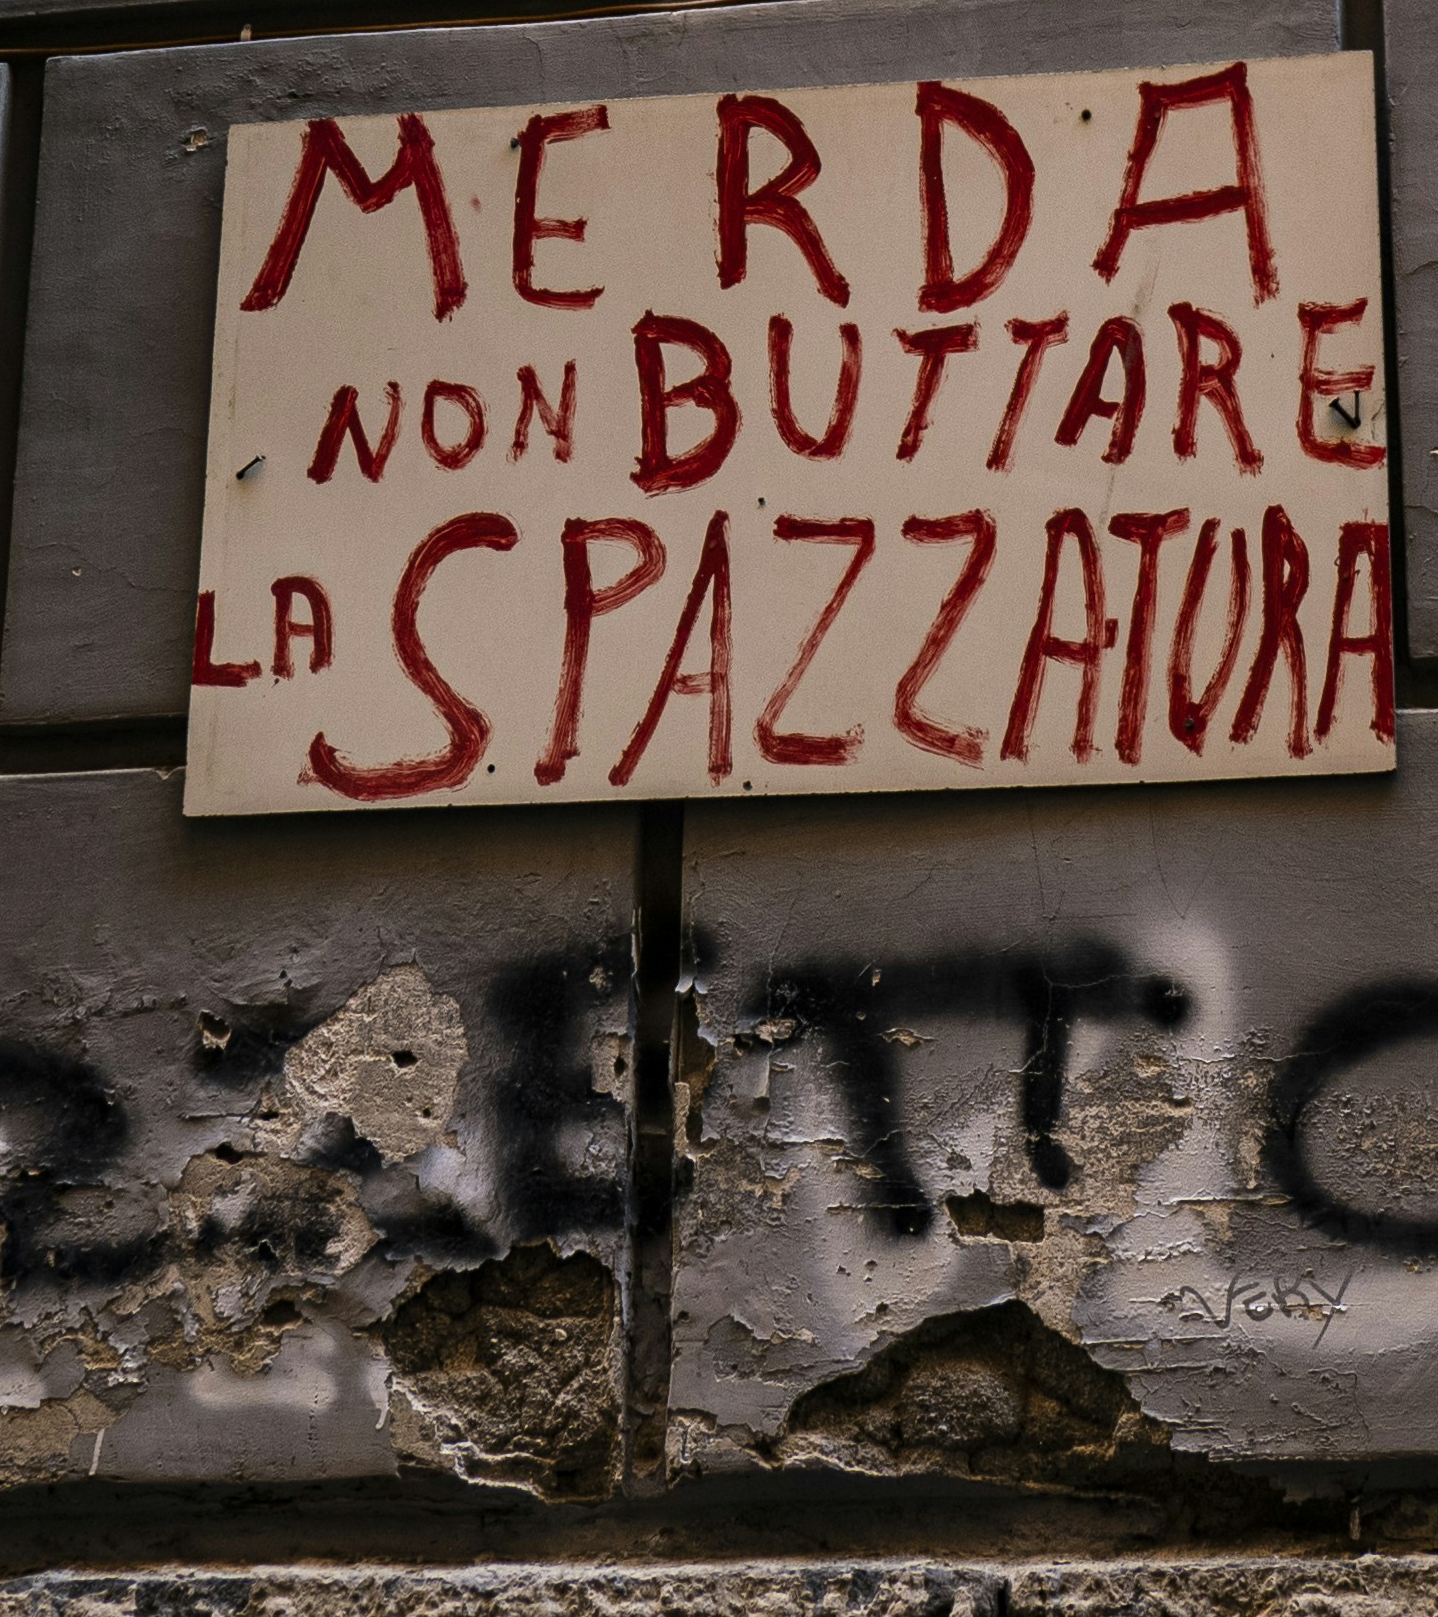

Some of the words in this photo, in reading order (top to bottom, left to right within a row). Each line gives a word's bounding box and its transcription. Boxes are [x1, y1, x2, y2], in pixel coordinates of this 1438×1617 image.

[239, 61, 1280, 323] MERDA
[305, 358, 579, 485] NON
[630, 295, 1386, 497] BUTTARE
[190, 573, 336, 688] LA
[298, 502, 1395, 802] SPAZZATURA
